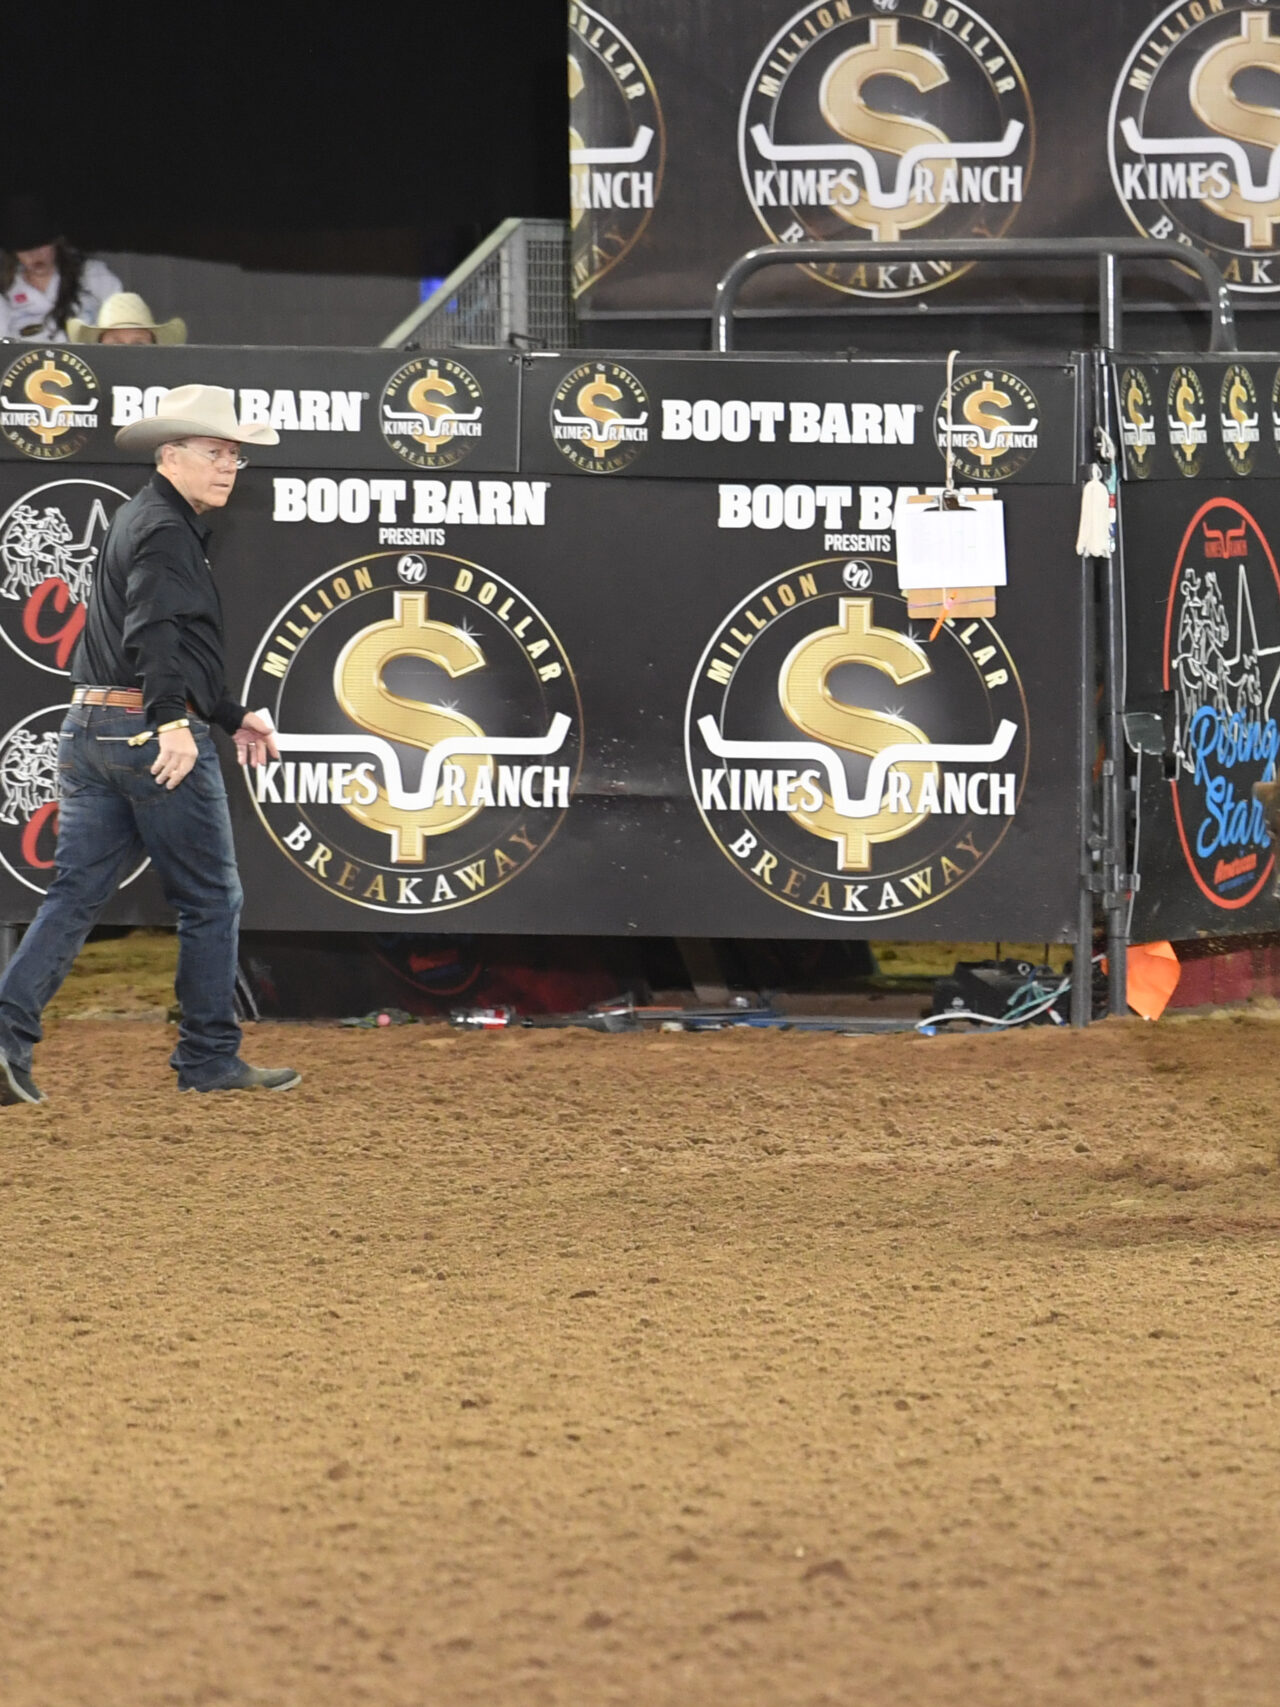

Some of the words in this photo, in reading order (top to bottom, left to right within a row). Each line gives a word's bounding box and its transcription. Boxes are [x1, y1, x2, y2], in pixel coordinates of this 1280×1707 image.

[757, 0, 853, 99] MILLION
[922, 0, 1017, 95] DOLLAR
[754, 168, 859, 207] KIMES
[914, 166, 1023, 204] RANCH
[1122, 162, 1232, 200] KIMES
[661, 399, 785, 442] BOOT
[788, 402, 917, 444] BARN
[272, 477, 407, 524] BOOT
[412, 479, 547, 526] BARN
[717, 483, 853, 531] BOOT
[378, 527, 446, 546] PRESENTS
[824, 533, 892, 553] PRESENTS
[262, 566, 374, 679] MILLION
[454, 568, 563, 683] DOLLAR
[706, 573, 818, 686] MILLION
[256, 761, 380, 805] KIMES
[442, 764, 571, 808] RANCH
[700, 768, 824, 812] KIMES
[887, 771, 1017, 815] RANCH
[282, 821, 538, 904] BREAKAWAY
[728, 828, 983, 912] BREAKAWAY
